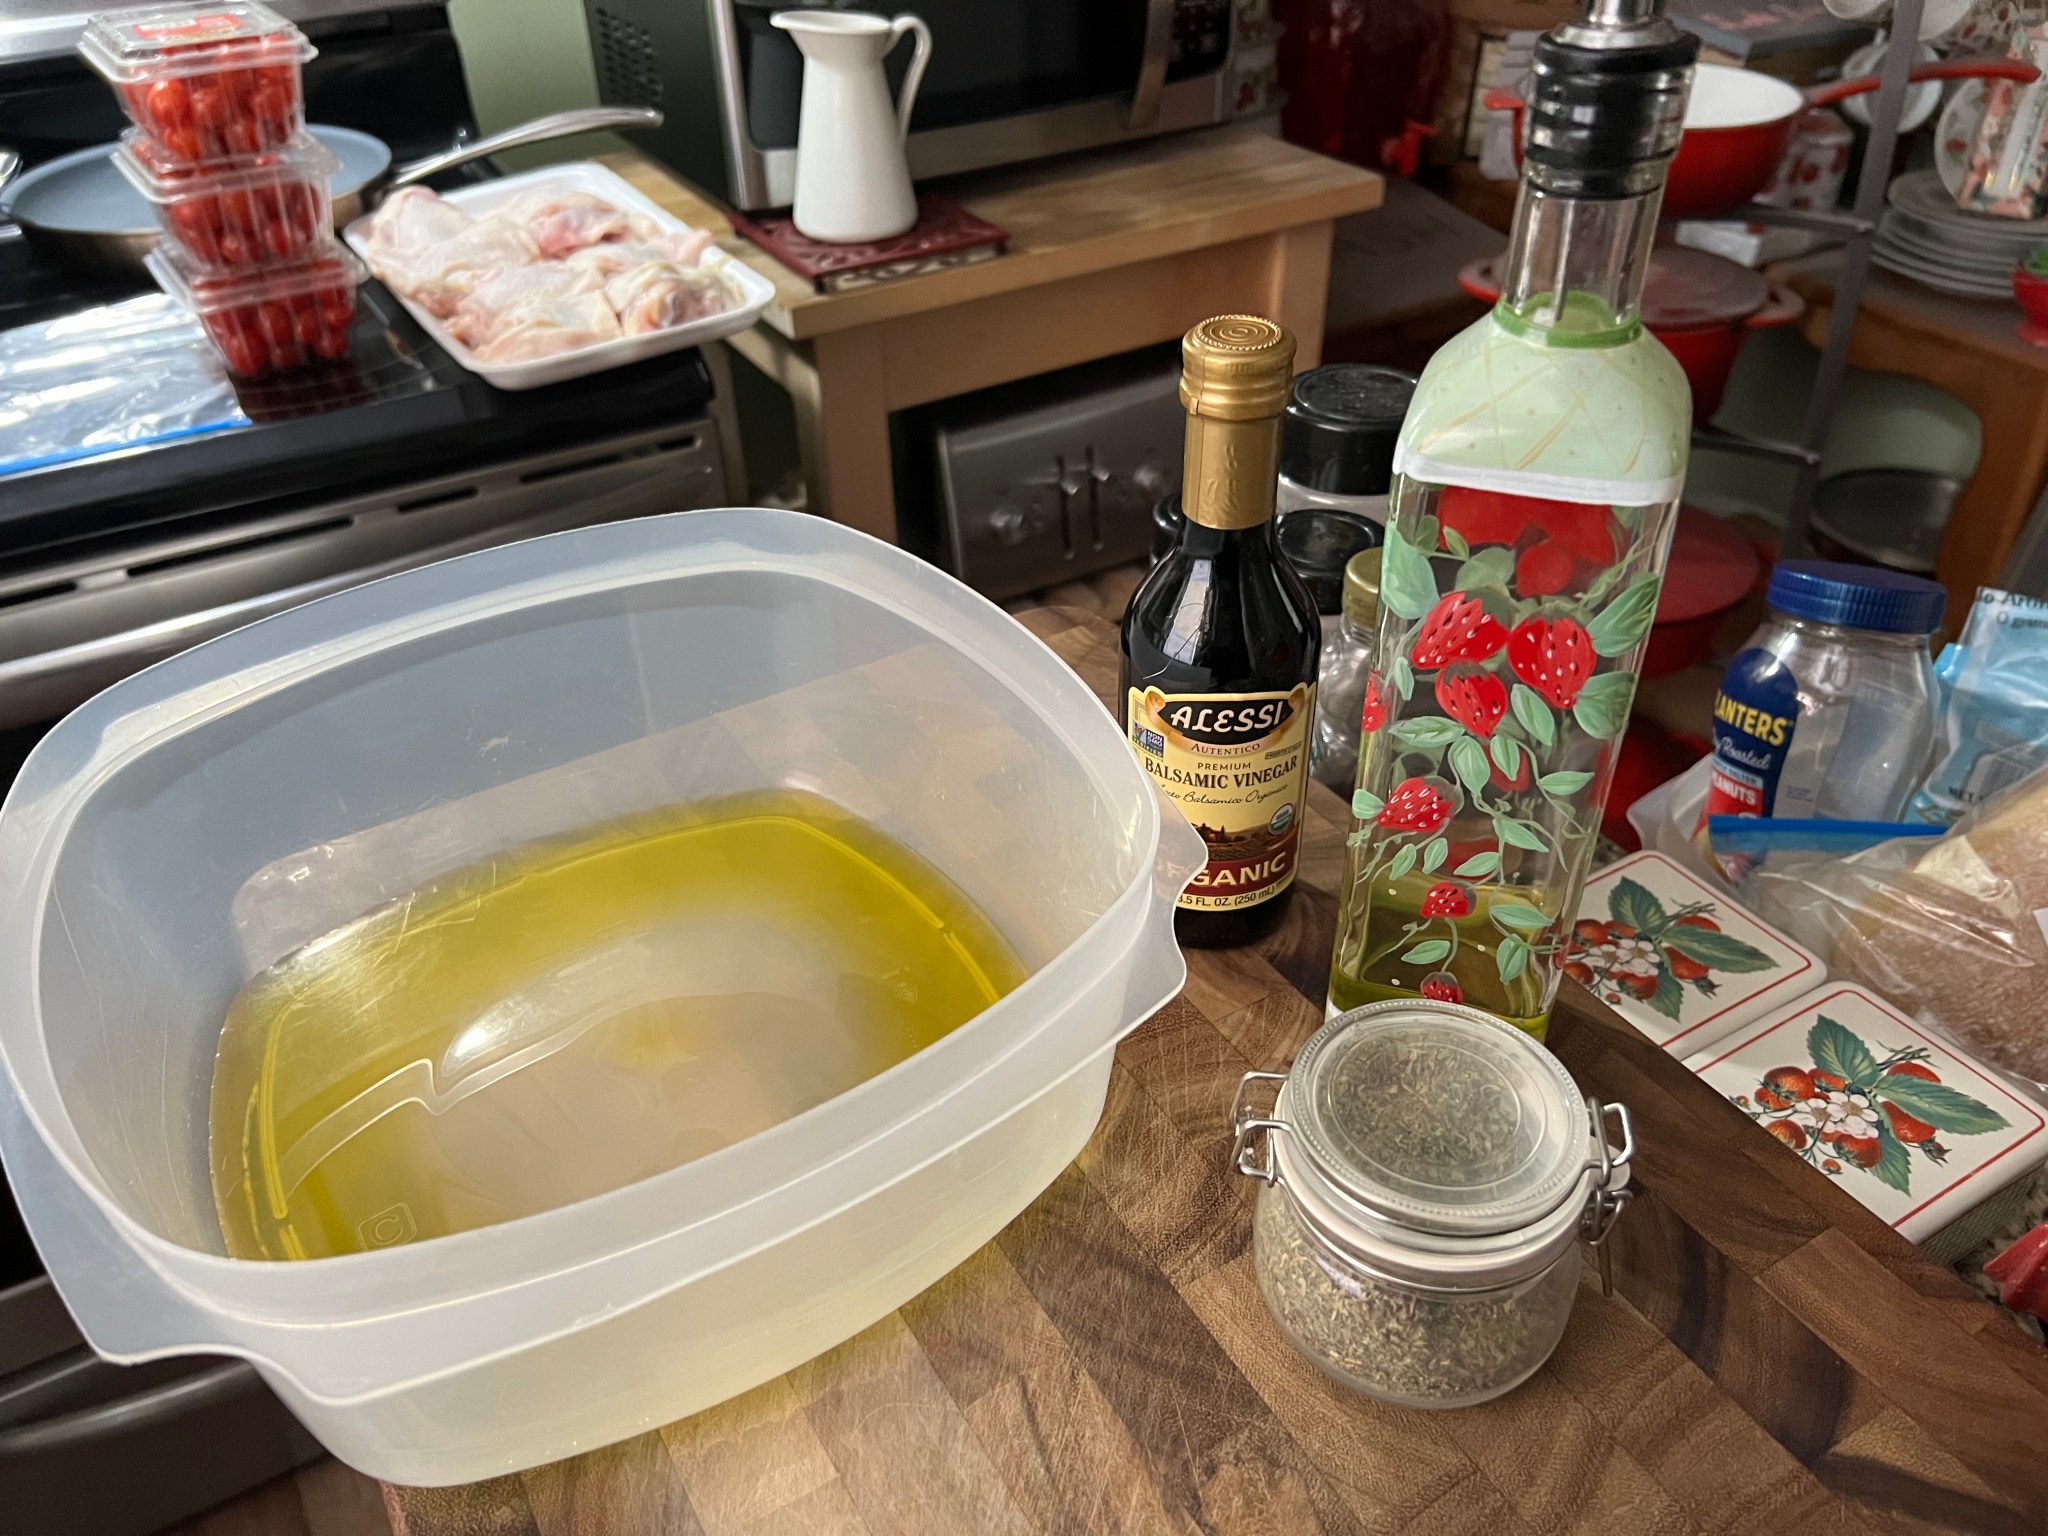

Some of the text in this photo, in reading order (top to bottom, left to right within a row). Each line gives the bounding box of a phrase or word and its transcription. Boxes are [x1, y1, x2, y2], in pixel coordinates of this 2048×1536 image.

[1170, 700, 1284, 733] ALESSI
[1714, 688, 1788, 747] LANTERS
[1147, 731, 1163, 743] NON
[1147, 737, 1163, 748] GMO
[1190, 743, 1260, 756] AUTENTICO
[1145, 755, 1298, 790] BALSAMIC VINEGAR
[1197, 761, 1252, 771] PREMIUM
[1182, 790, 1243, 804] Balsamico
[1190, 850, 1287, 888] GANIC
[1234, 892, 1256, 907] (250
[1258, 884, 1275, 899] mL)
